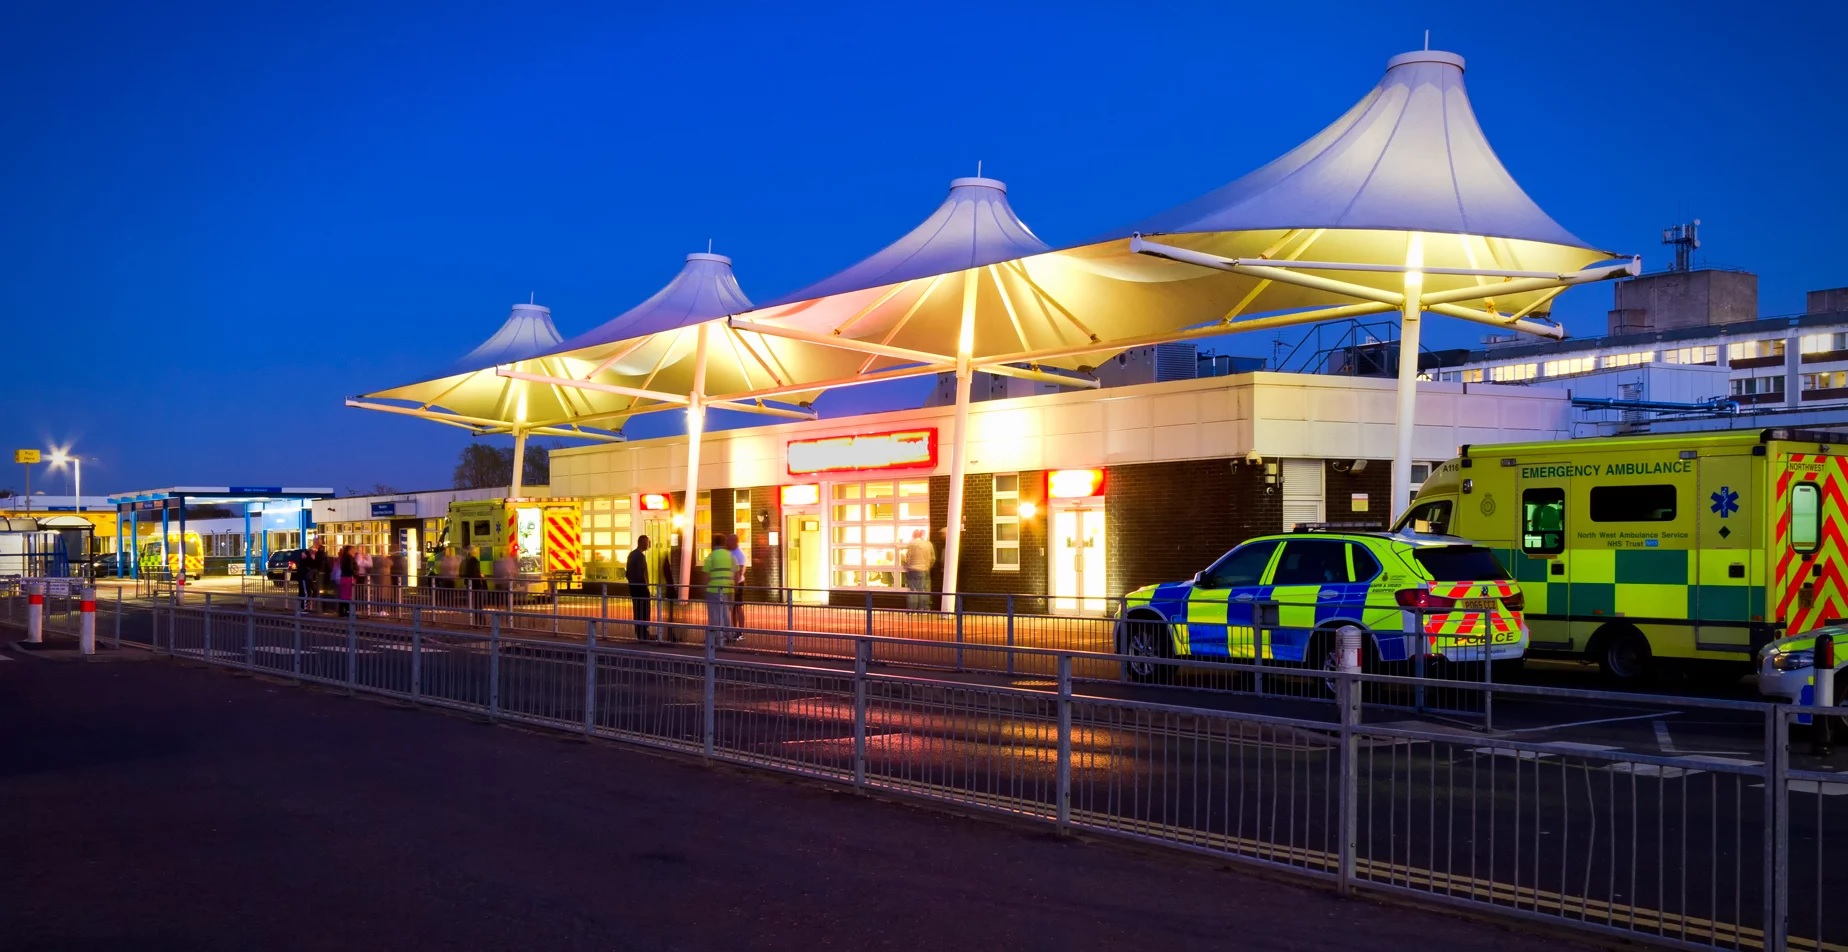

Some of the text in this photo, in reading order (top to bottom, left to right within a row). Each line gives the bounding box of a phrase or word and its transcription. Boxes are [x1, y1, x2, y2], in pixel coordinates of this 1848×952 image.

[1443, 464, 1460, 472] A116
[1522, 462, 1692, 478] EMERGENCY AMBULANCE
[1454, 632, 1514, 644] POLICE
